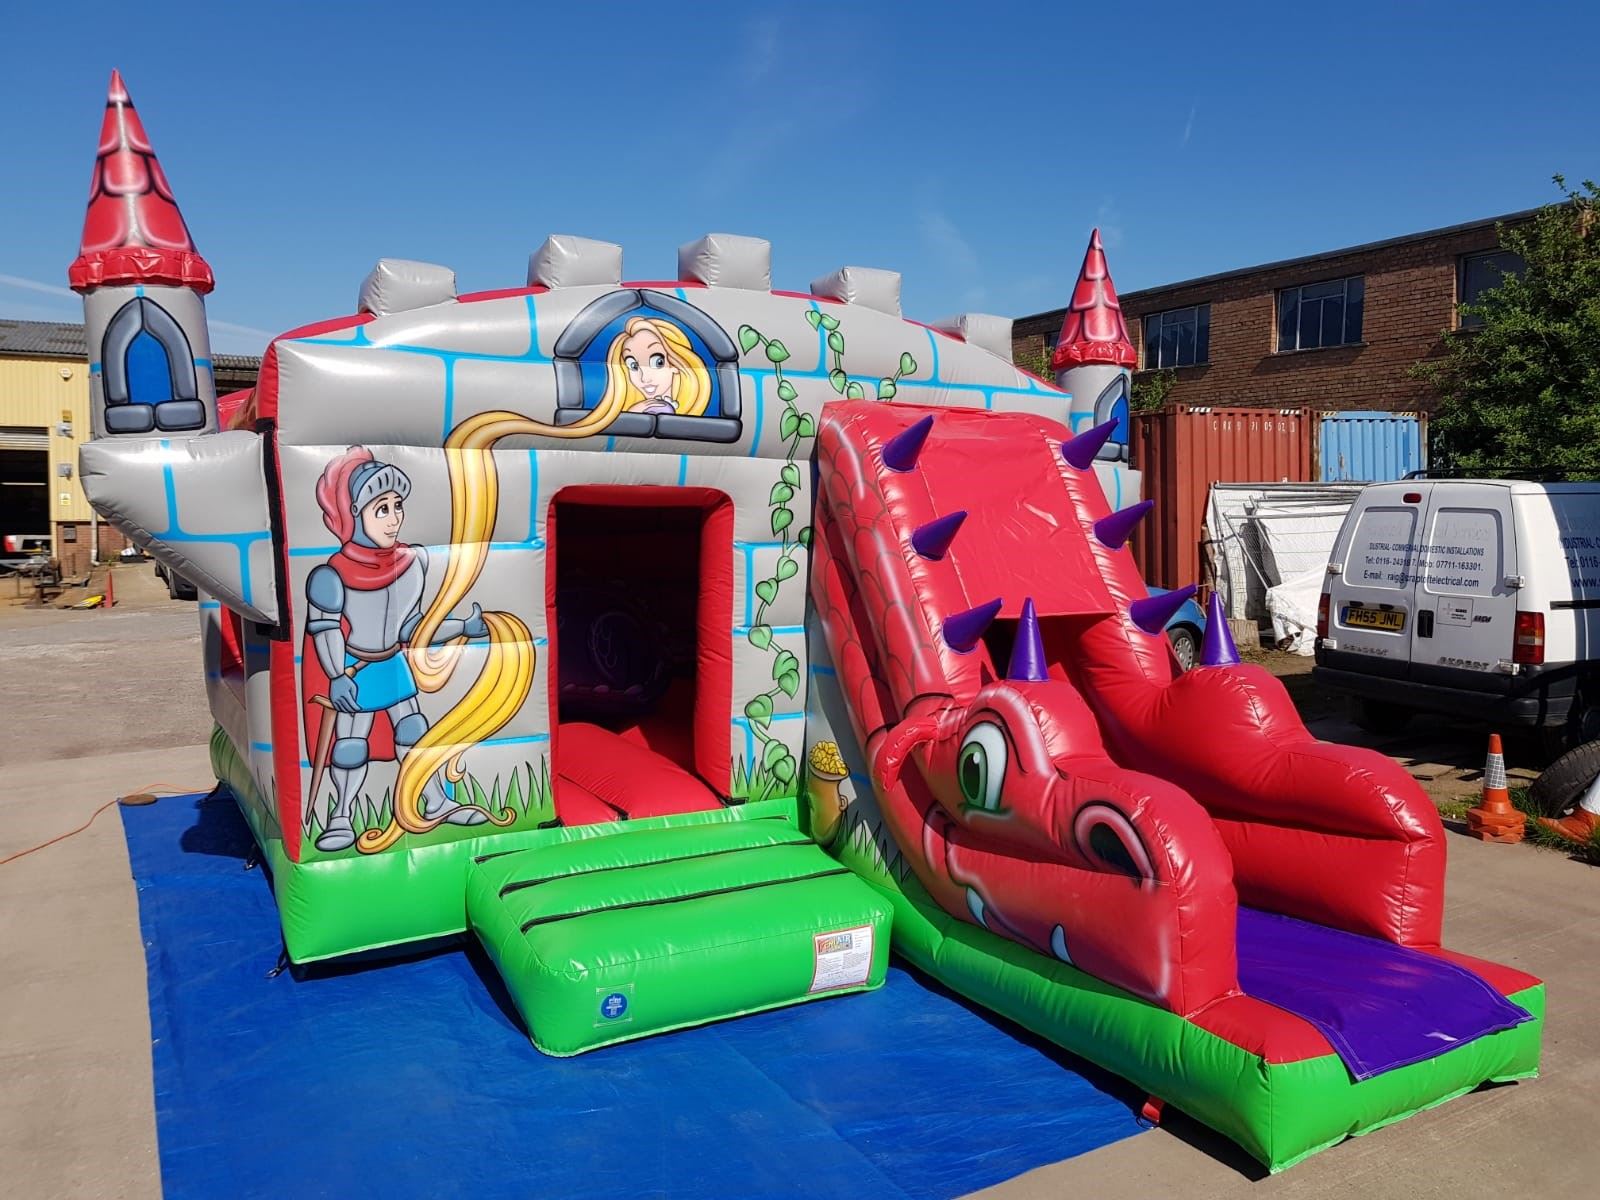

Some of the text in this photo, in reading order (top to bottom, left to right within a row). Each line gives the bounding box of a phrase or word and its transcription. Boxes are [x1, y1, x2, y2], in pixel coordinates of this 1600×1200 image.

[1365, 556, 1375, 565] Tel:
[1348, 609, 1402, 627] FH55 JNL
